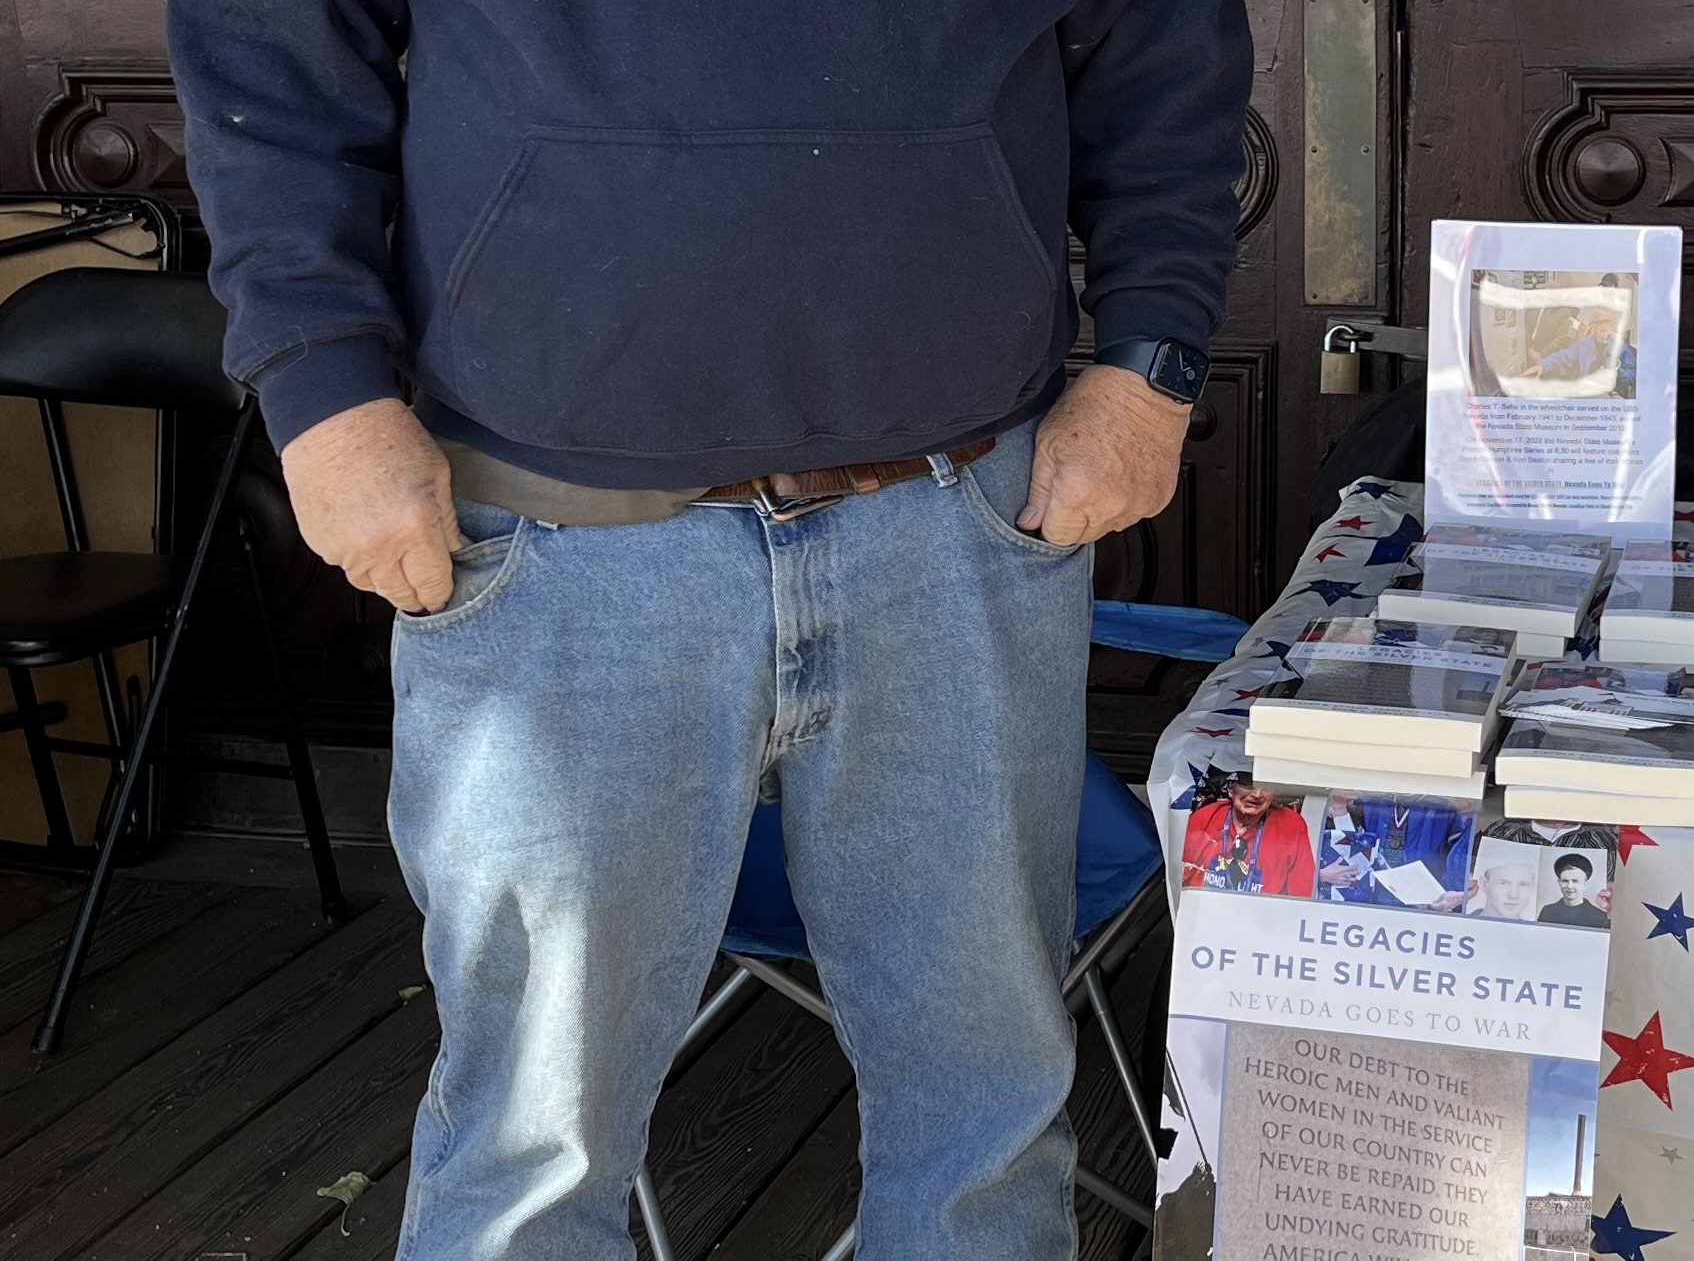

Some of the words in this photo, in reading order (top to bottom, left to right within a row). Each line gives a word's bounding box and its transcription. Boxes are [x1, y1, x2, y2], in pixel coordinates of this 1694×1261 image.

[1507, 413, 1535, 422] February
[1564, 414, 1597, 422] December
[1540, 404, 1575, 412] wheelchair
[1572, 424, 1607, 432] September
[1374, 652, 1432, 661] SILVER
[1441, 658, 1492, 668] STATE
[1204, 872, 1226, 889] HONO
[1298, 919, 1476, 959] LEGACIES
[1191, 946, 1236, 973] OF
[1252, 952, 1317, 982] THE
[1334, 961, 1456, 996] SILVER
[1473, 976, 1583, 1010] STATE
[1228, 991, 1332, 1019] NEVADA
[1346, 1003, 1414, 1030] GOES
[1427, 1013, 1461, 1032] TO
[1474, 1019, 1531, 1040] WAR
[1295, 1039, 1341, 1066] OUR
[1349, 1048, 1399, 1076] DEBT
[1404, 1065, 1429, 1086] TO
[1436, 1072, 1469, 1096] THE
[1245, 1057, 1329, 1089] HEROIC
[1335, 1075, 1379, 1100] MEN
[1387, 1088, 1427, 1112] AND
[1433, 1098, 1505, 1130] VALIANT
[1258, 1089, 1346, 1125] WOMEN
[1353, 1108, 1372, 1127] IN
[1380, 1114, 1417, 1137] THE
[1423, 1124, 1492, 1153] SERVICE
[1262, 1121, 1292, 1141] OF
[1298, 1127, 1344, 1152] OUR
[1352, 1136, 1446, 1170] COUNTRY
[1451, 1157, 1487, 1178] CAN
[1260, 1151, 1330, 1179] NEVER
[1338, 1162, 1361, 1181] BE
[1367, 1166, 1440, 1198] REPAID.
[1444, 1182, 1488, 1204] THEY
[1275, 1183, 1333, 1207] HAVE
[1342, 1193, 1422, 1220] EARNED
[1429, 1207, 1469, 1227] OUR
[1265, 1212, 1365, 1240] UNDYING
[1372, 1226, 1479, 1256] GRATITUDE.
